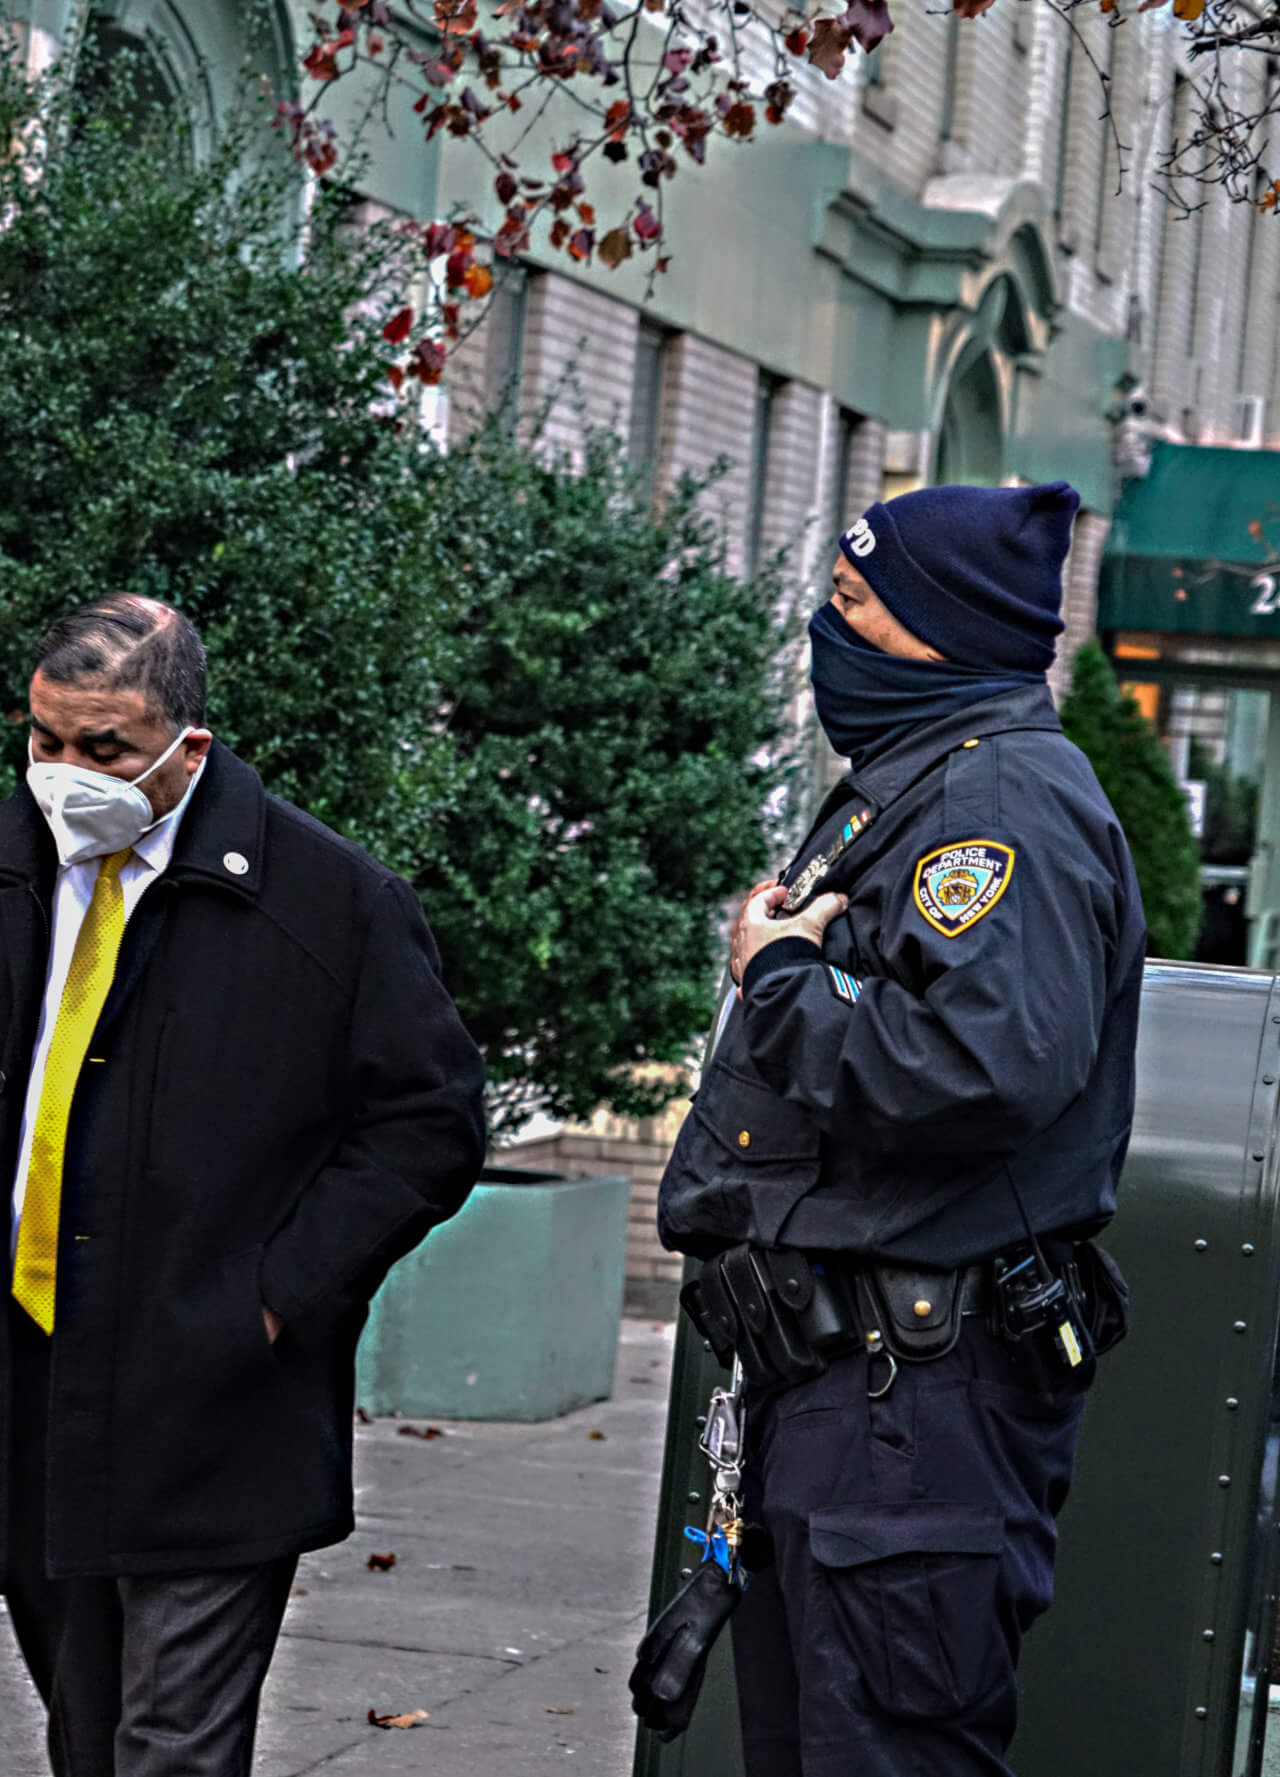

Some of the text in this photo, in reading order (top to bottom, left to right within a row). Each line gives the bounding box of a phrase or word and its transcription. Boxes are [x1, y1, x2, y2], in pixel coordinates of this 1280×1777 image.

[1251, 574, 1280, 615] 2
[941, 847, 986, 861] POLICE
[923, 857, 1002, 879] DEPARTMENT
